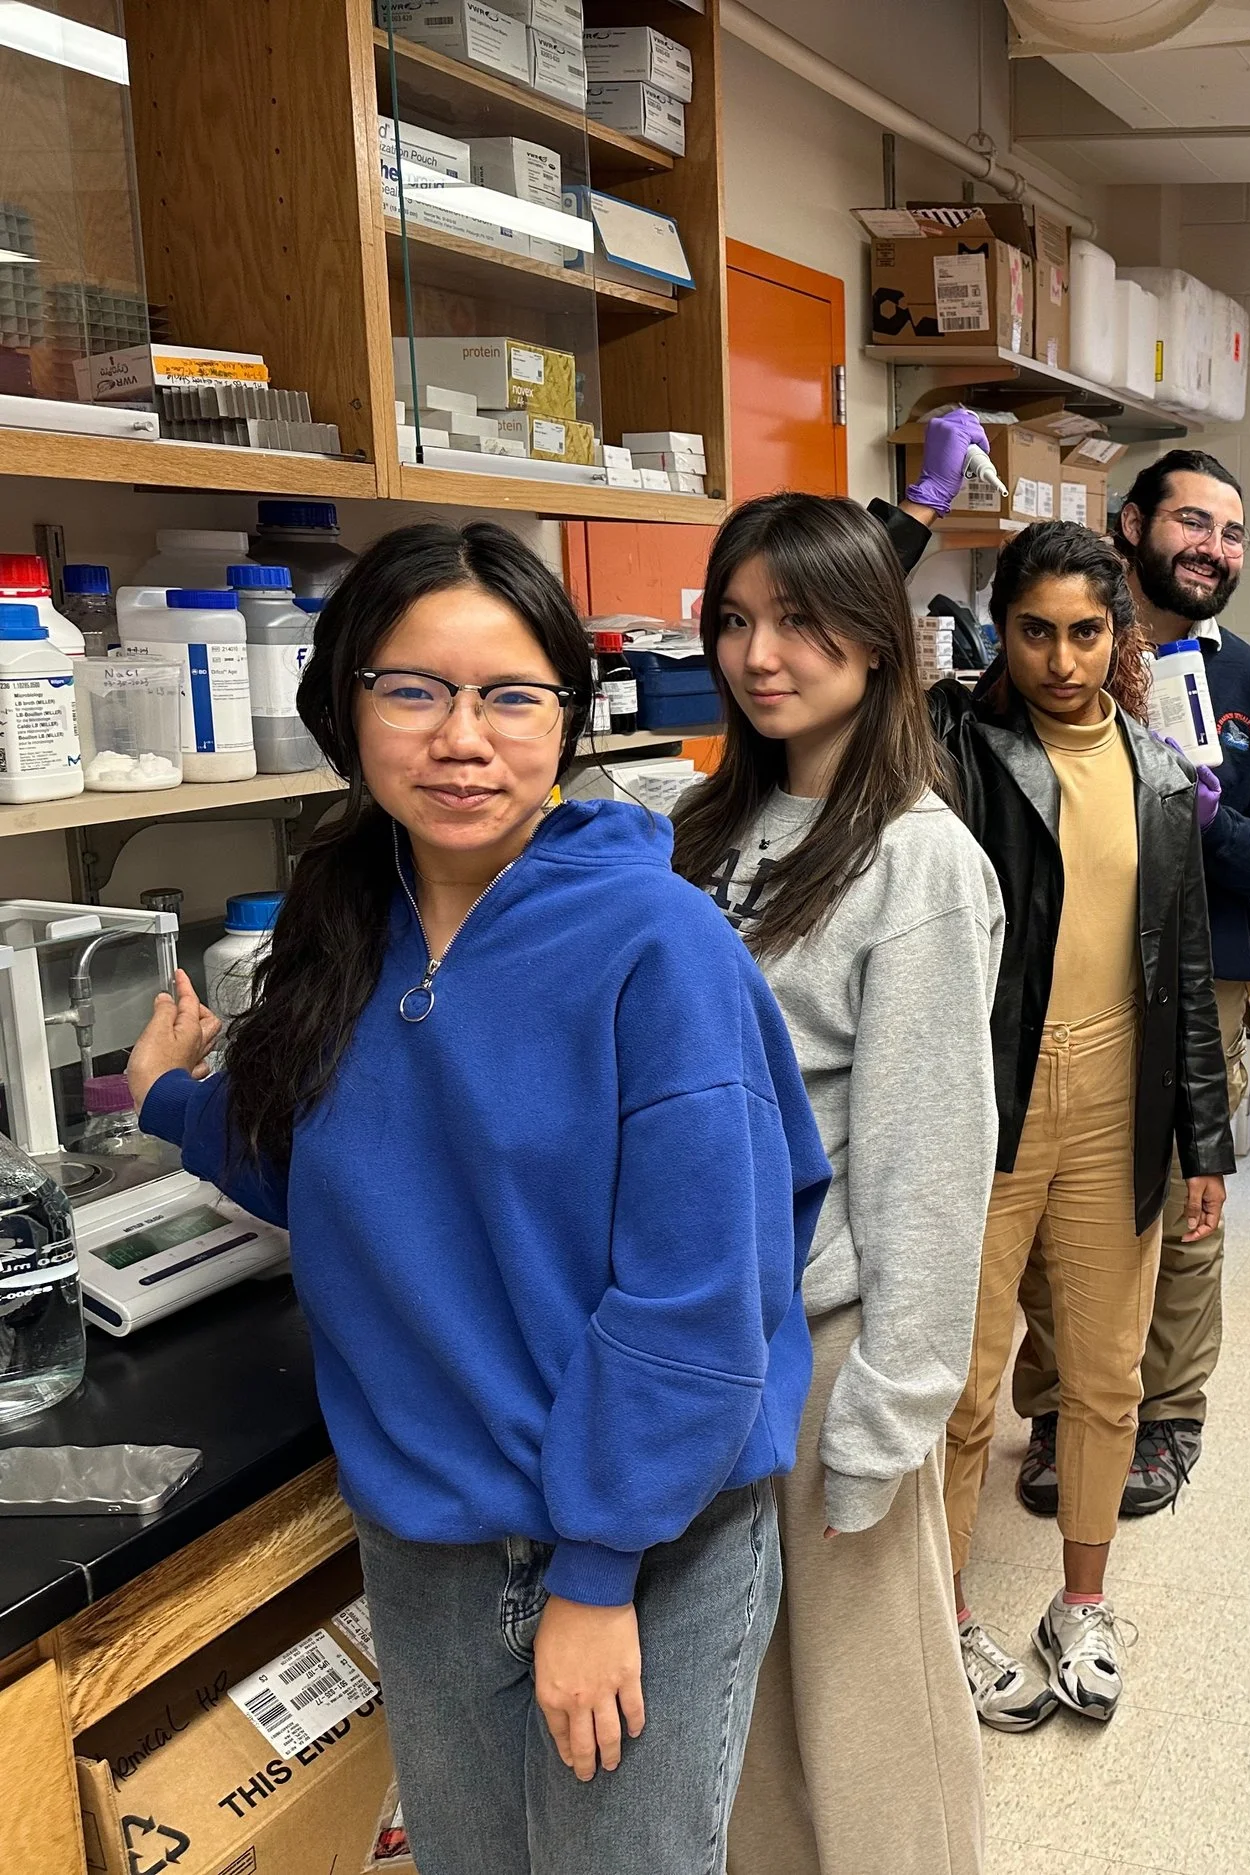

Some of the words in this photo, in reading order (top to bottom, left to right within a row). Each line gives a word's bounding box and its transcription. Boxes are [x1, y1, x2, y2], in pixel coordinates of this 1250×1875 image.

[467, 3, 485, 15] VWR
[538, 39, 553, 49] VWR
[411, 152, 438, 167] Pouch
[463, 346, 500, 360] protein
[116, 376, 138, 387] VWR
[512, 385, 534, 397] novex
[498, 420, 522, 432] otein
[306, 1660, 330, 1680] UPS-107
[316, 1680, 348, 1706] 501-035-77
[218, 1758, 293, 1819] THIS
[294, 1716, 351, 1767] END
